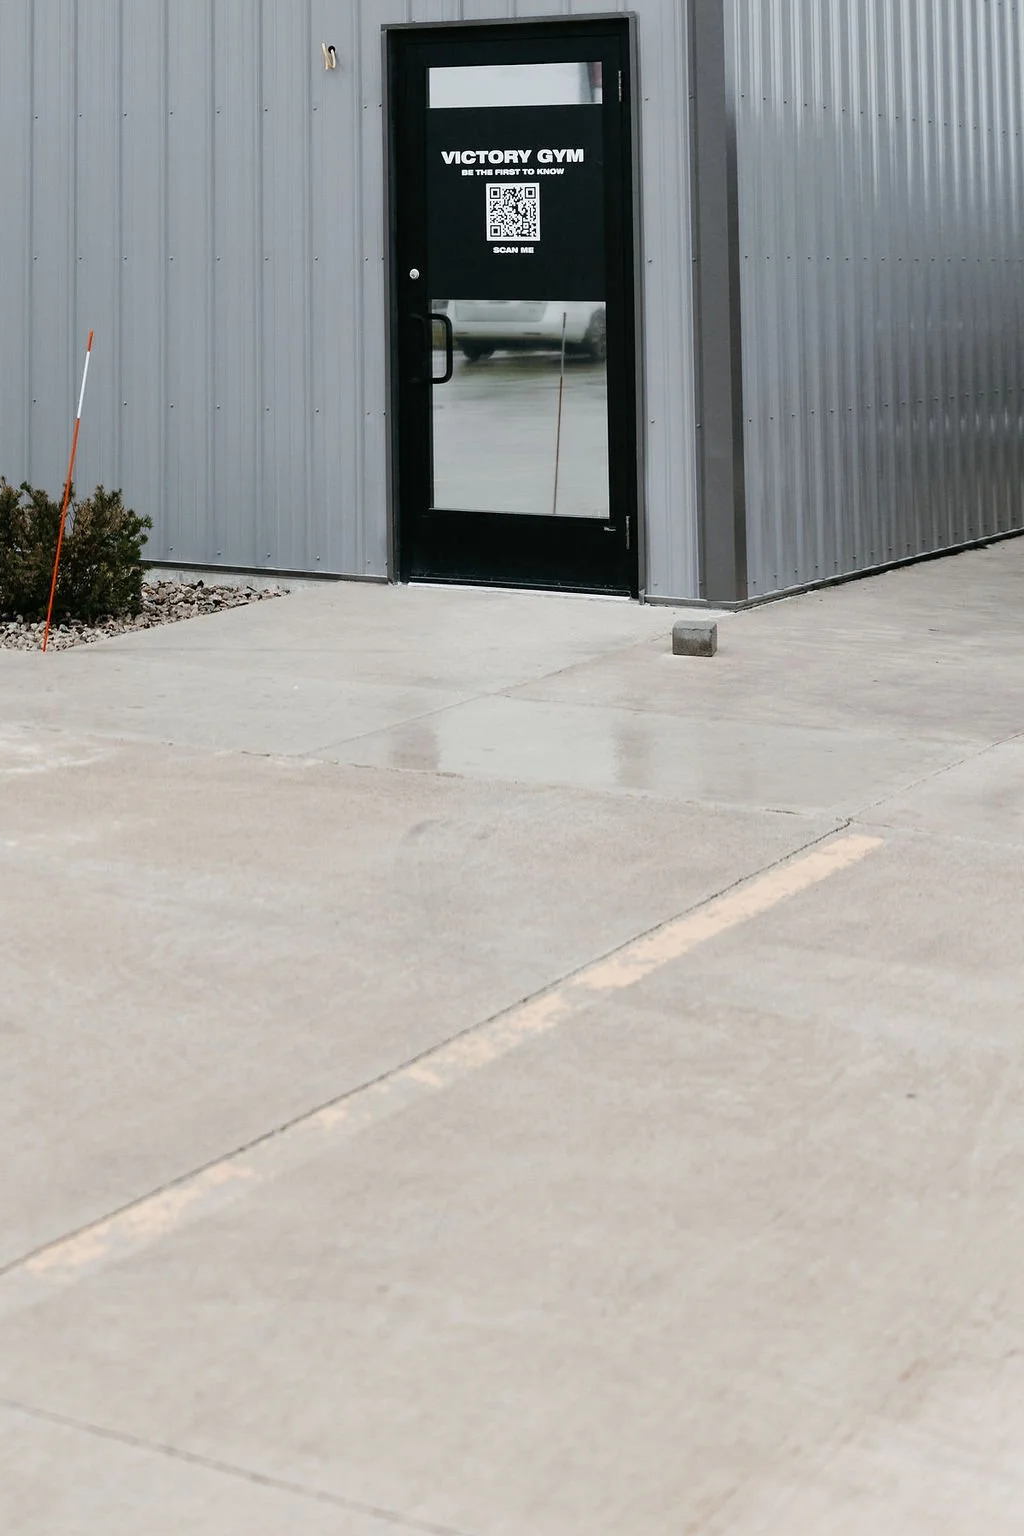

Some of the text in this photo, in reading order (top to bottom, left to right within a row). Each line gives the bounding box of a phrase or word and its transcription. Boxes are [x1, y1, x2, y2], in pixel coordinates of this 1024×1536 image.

[441, 148, 585, 165] VICTORY GYM
[495, 168, 521, 176] FIRST
[522, 168, 535, 176] TO
[493, 246, 534, 254] SCAN ME
